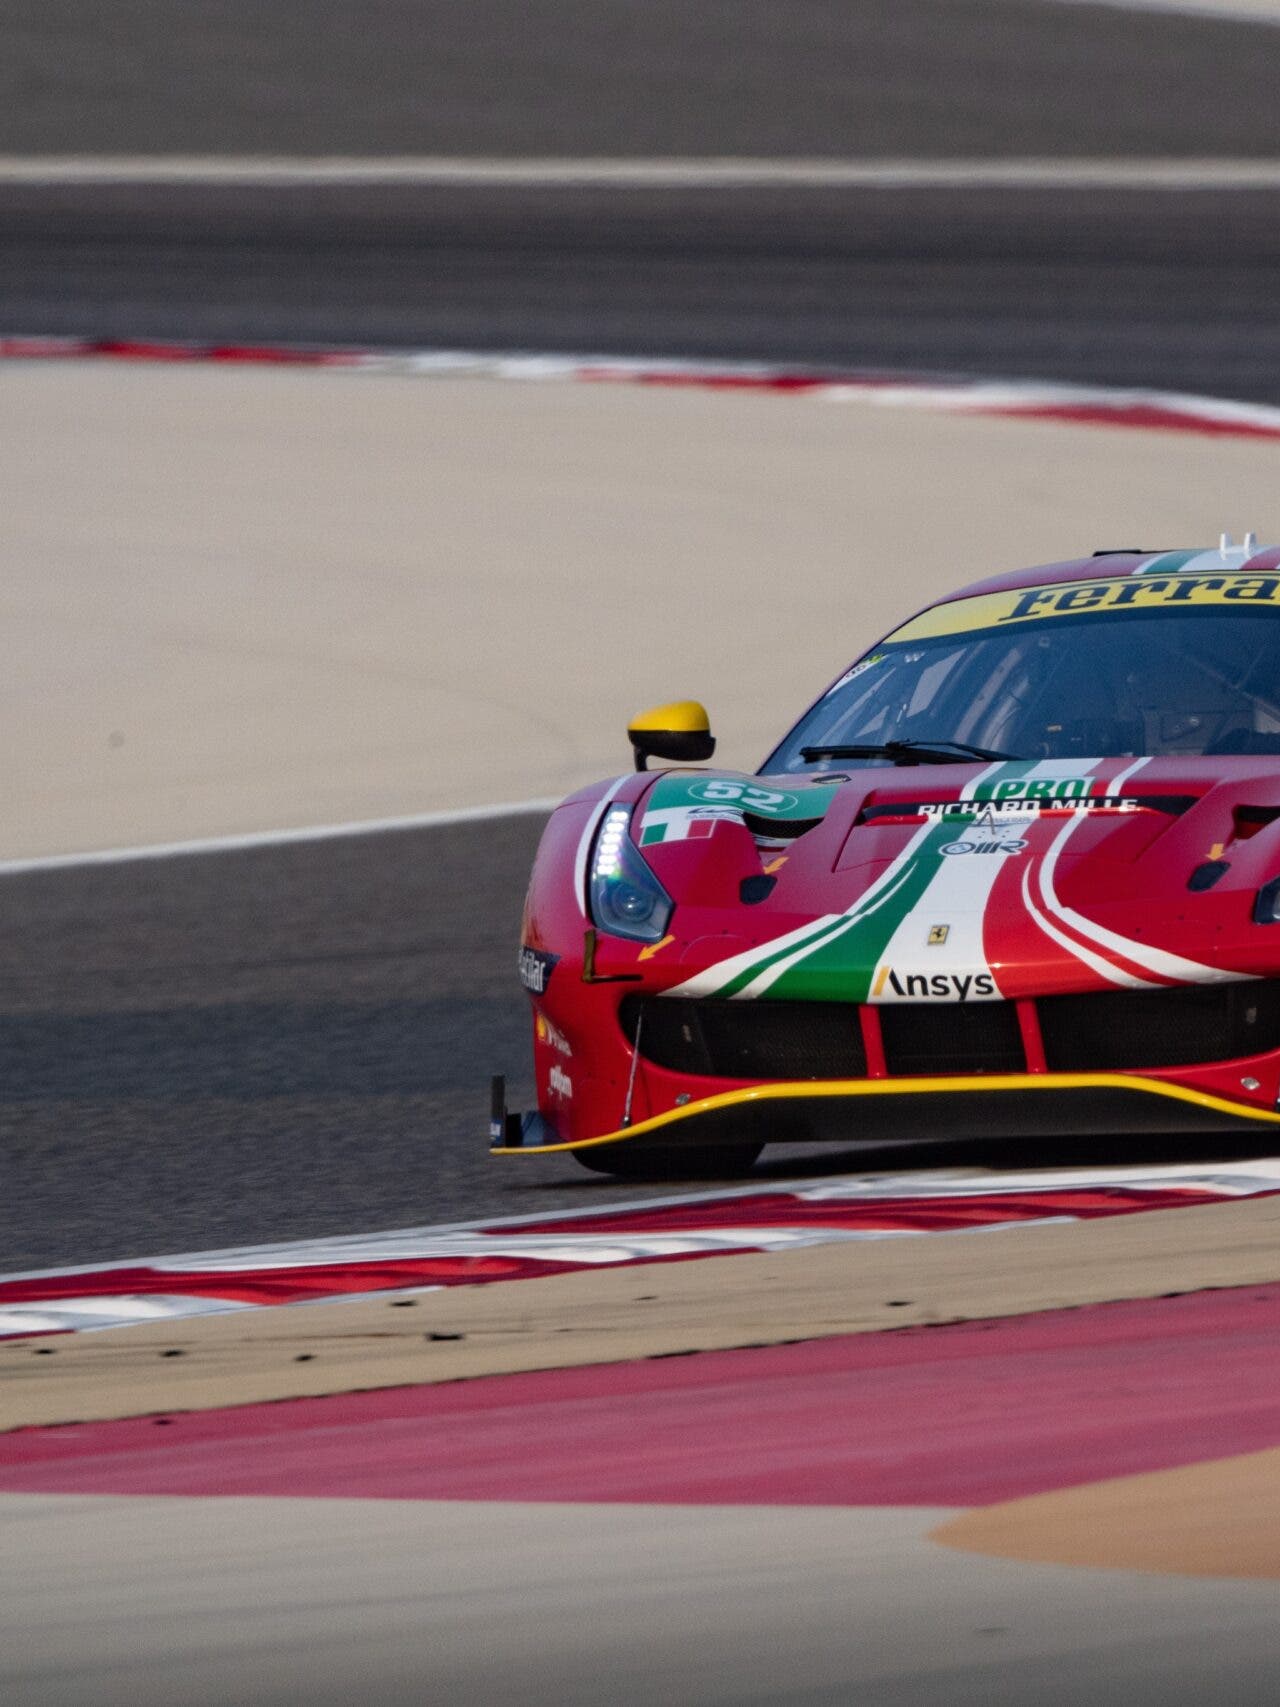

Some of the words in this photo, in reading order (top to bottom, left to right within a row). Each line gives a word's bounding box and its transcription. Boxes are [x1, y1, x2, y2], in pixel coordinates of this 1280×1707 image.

[702, 781, 784, 813] 52
[916, 799, 1040, 817] RICHARD
[1050, 799, 1138, 811] MILLE
[871, 965, 994, 1001] Ansys
